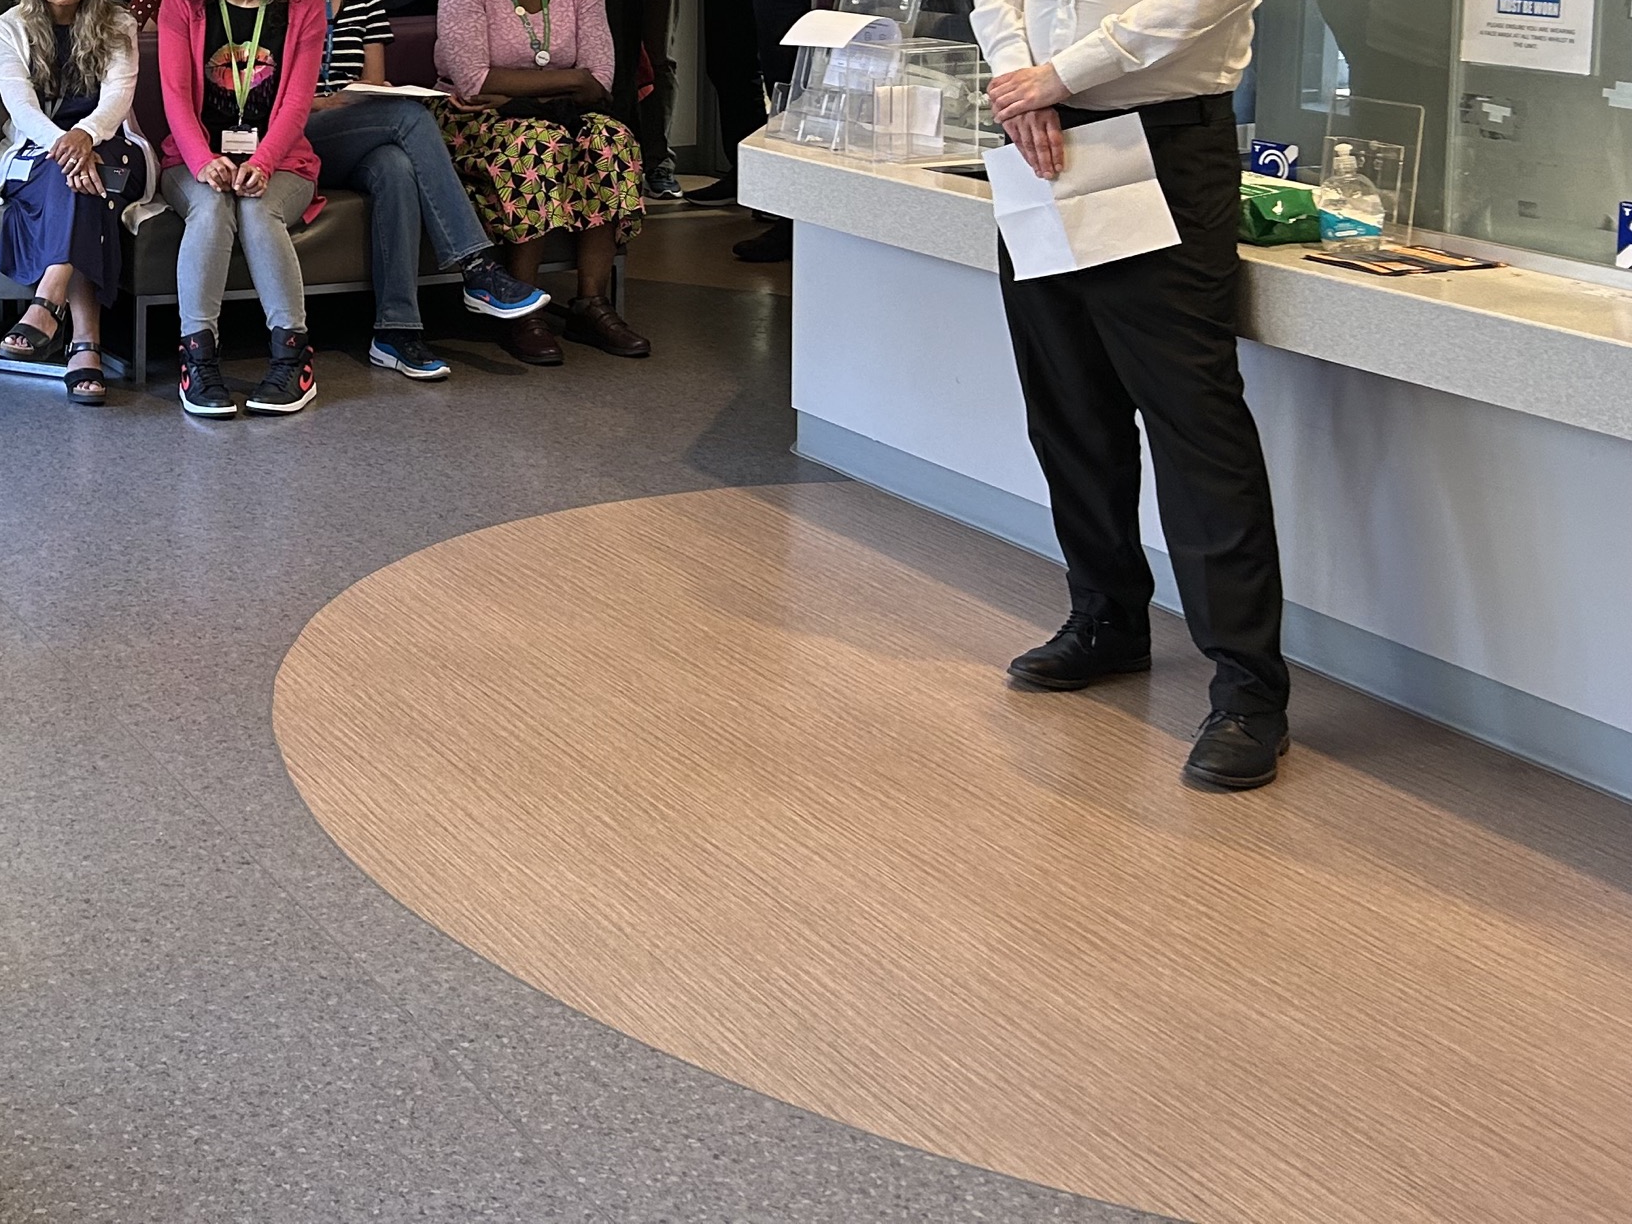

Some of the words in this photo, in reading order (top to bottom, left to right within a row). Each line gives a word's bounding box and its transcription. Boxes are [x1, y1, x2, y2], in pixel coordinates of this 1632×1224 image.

[1499, 0, 1521, 13] MUST
[1522, 1, 1533, 14] BE
[1534, 2, 1560, 16] WORN
